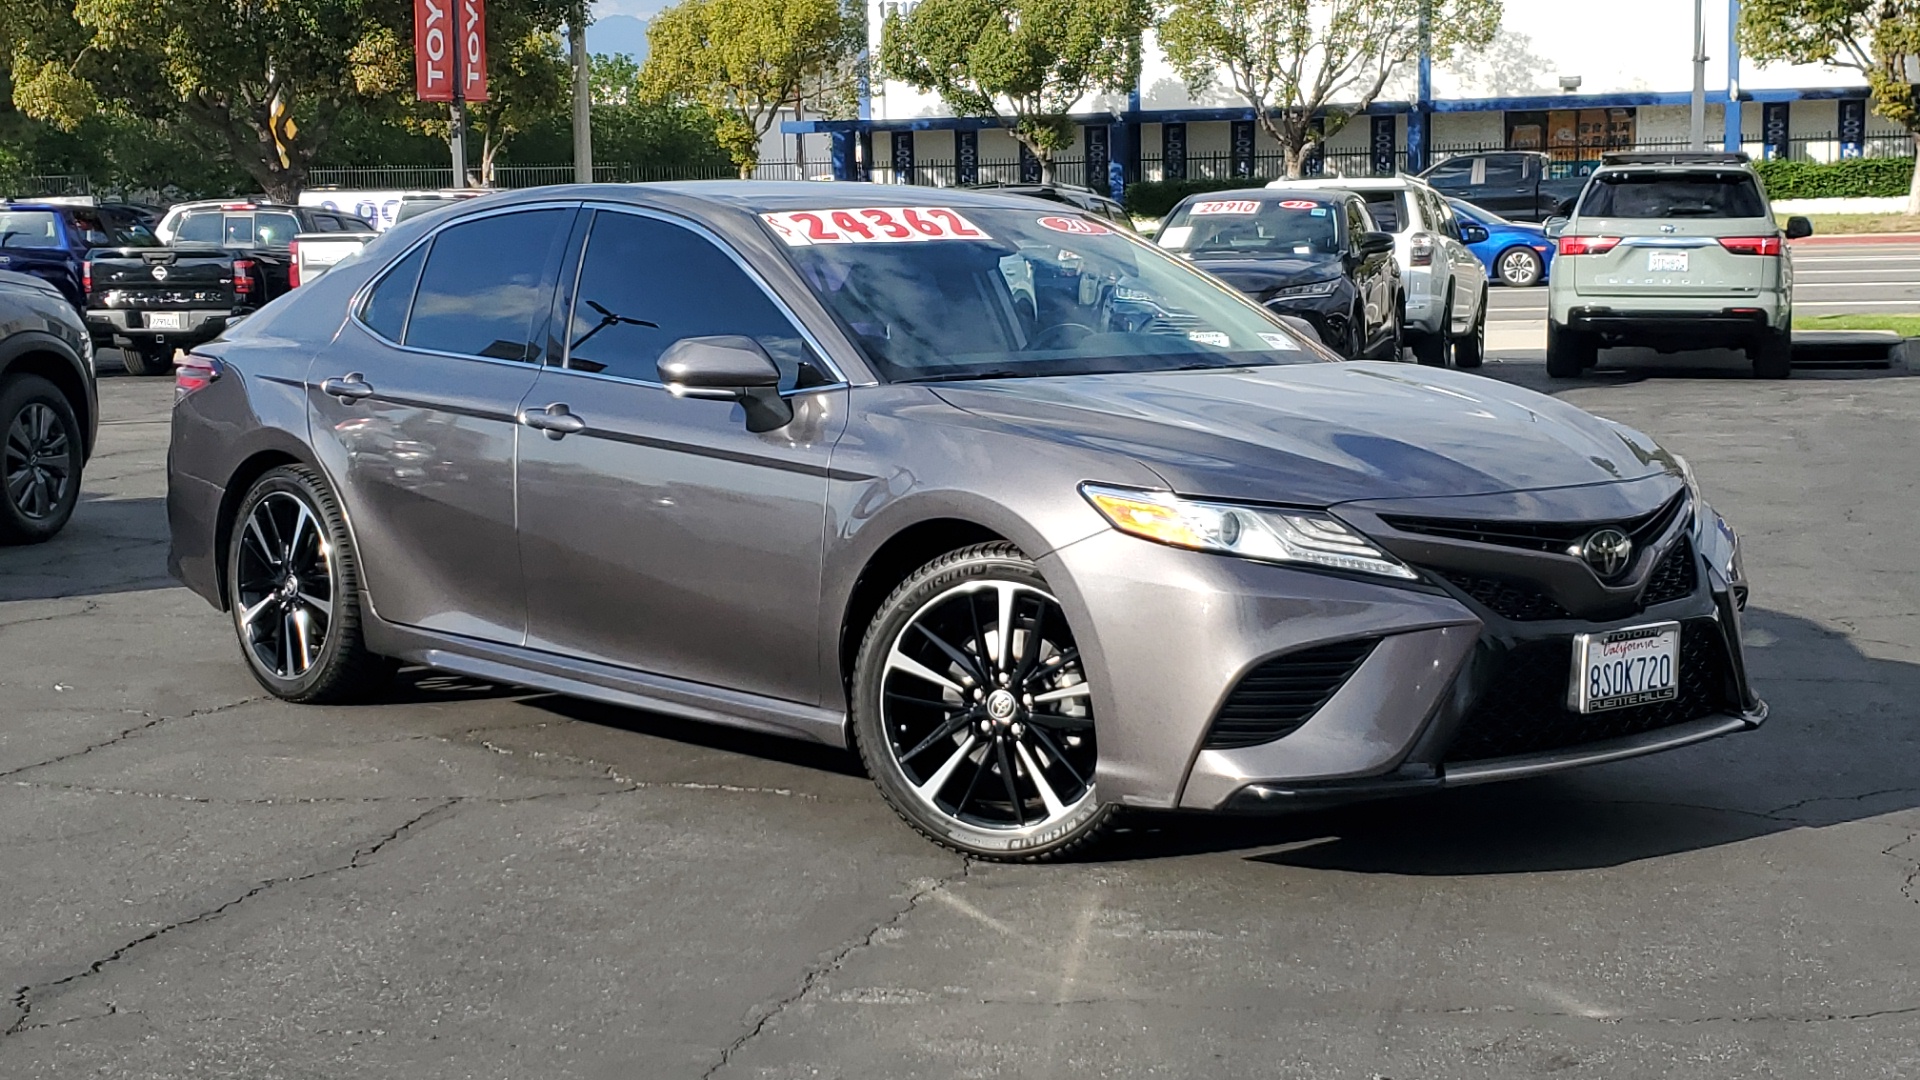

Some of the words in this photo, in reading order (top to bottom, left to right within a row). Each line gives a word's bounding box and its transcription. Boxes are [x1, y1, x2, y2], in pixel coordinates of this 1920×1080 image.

[465, 0, 480, 90] TOY
[1609, 628, 1659, 642] TOYOTA
[1602, 639, 1660, 658] California
[1590, 695, 1637, 709] PUENTE
[1638, 689, 1673, 702] HILLS
[1010, 819, 1077, 849] MICHELIN
